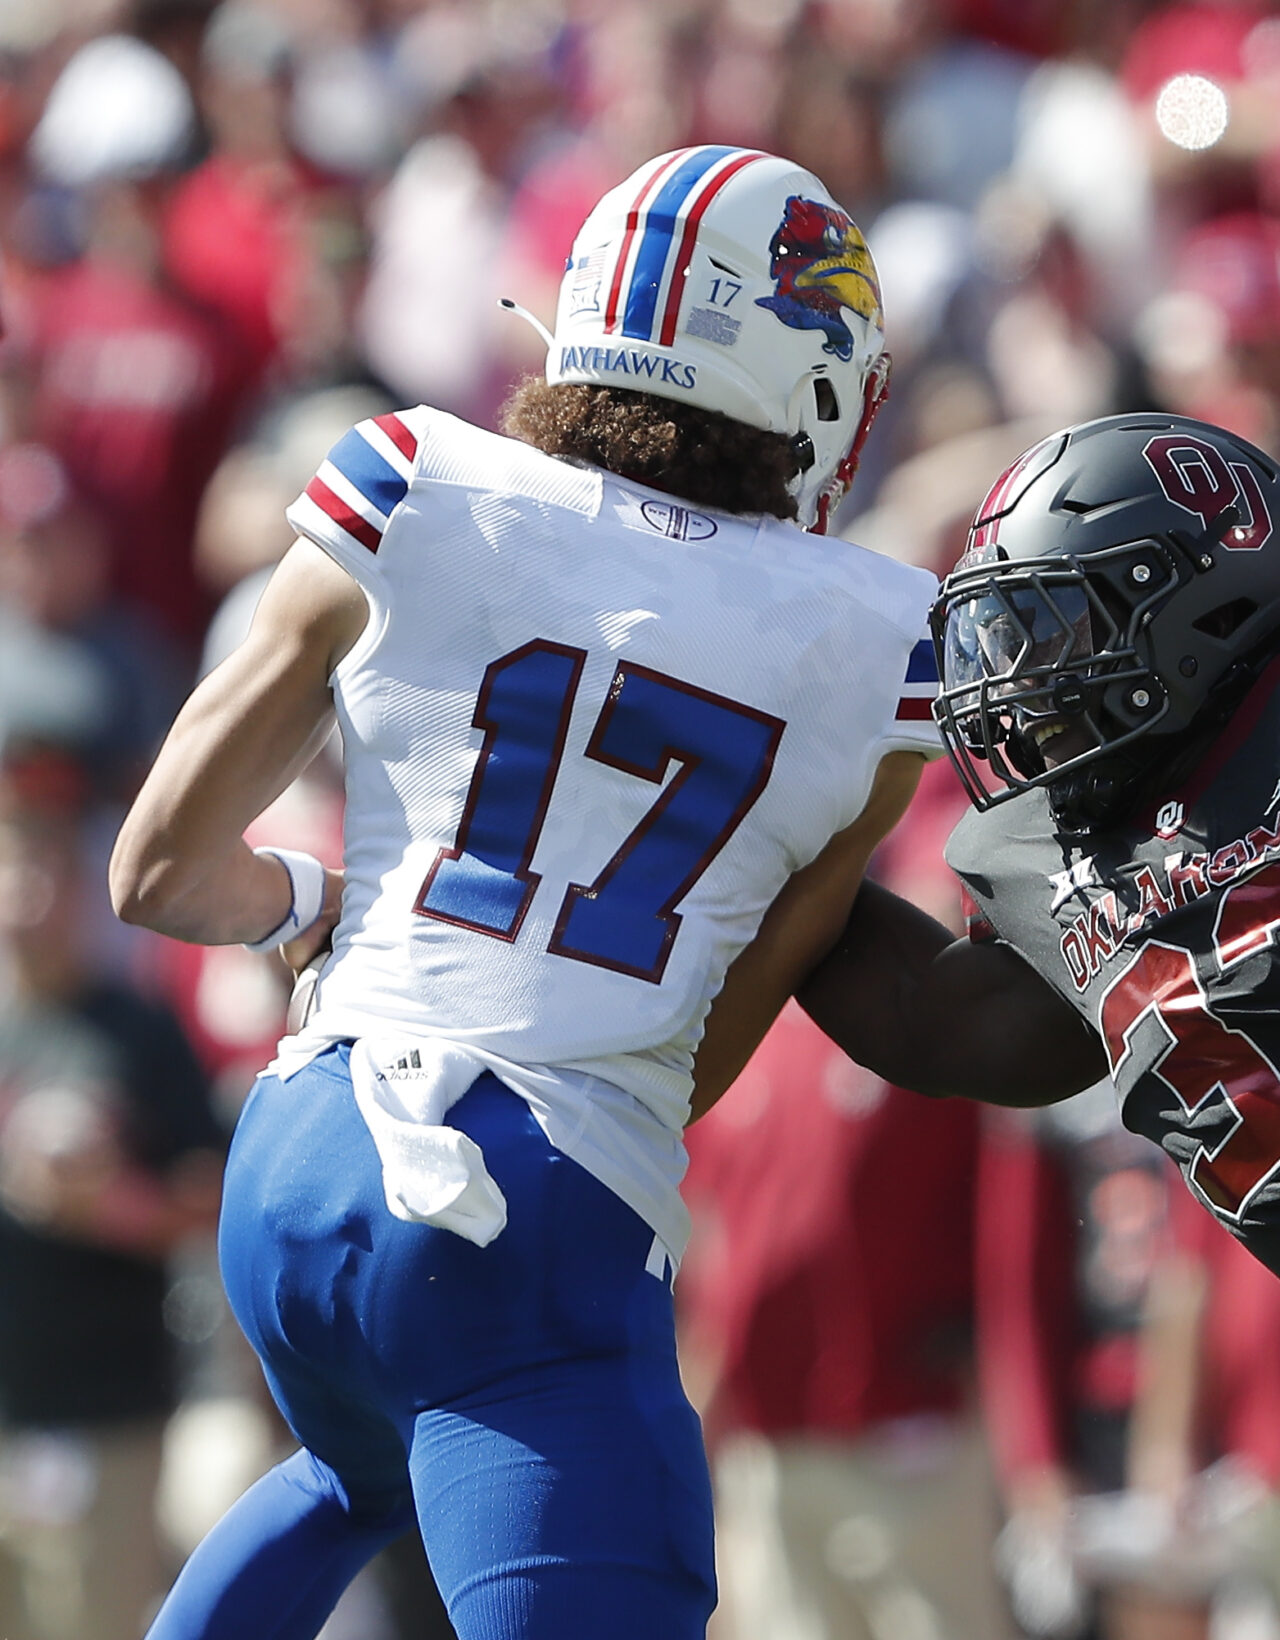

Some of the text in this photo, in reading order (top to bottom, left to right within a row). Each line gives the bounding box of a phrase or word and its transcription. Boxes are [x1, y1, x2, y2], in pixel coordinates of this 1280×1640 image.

[705, 278, 743, 308] 17
[559, 345, 698, 390] JAYHAWKS
[1141, 433, 1274, 552] OU
[410, 637, 788, 985] 17
